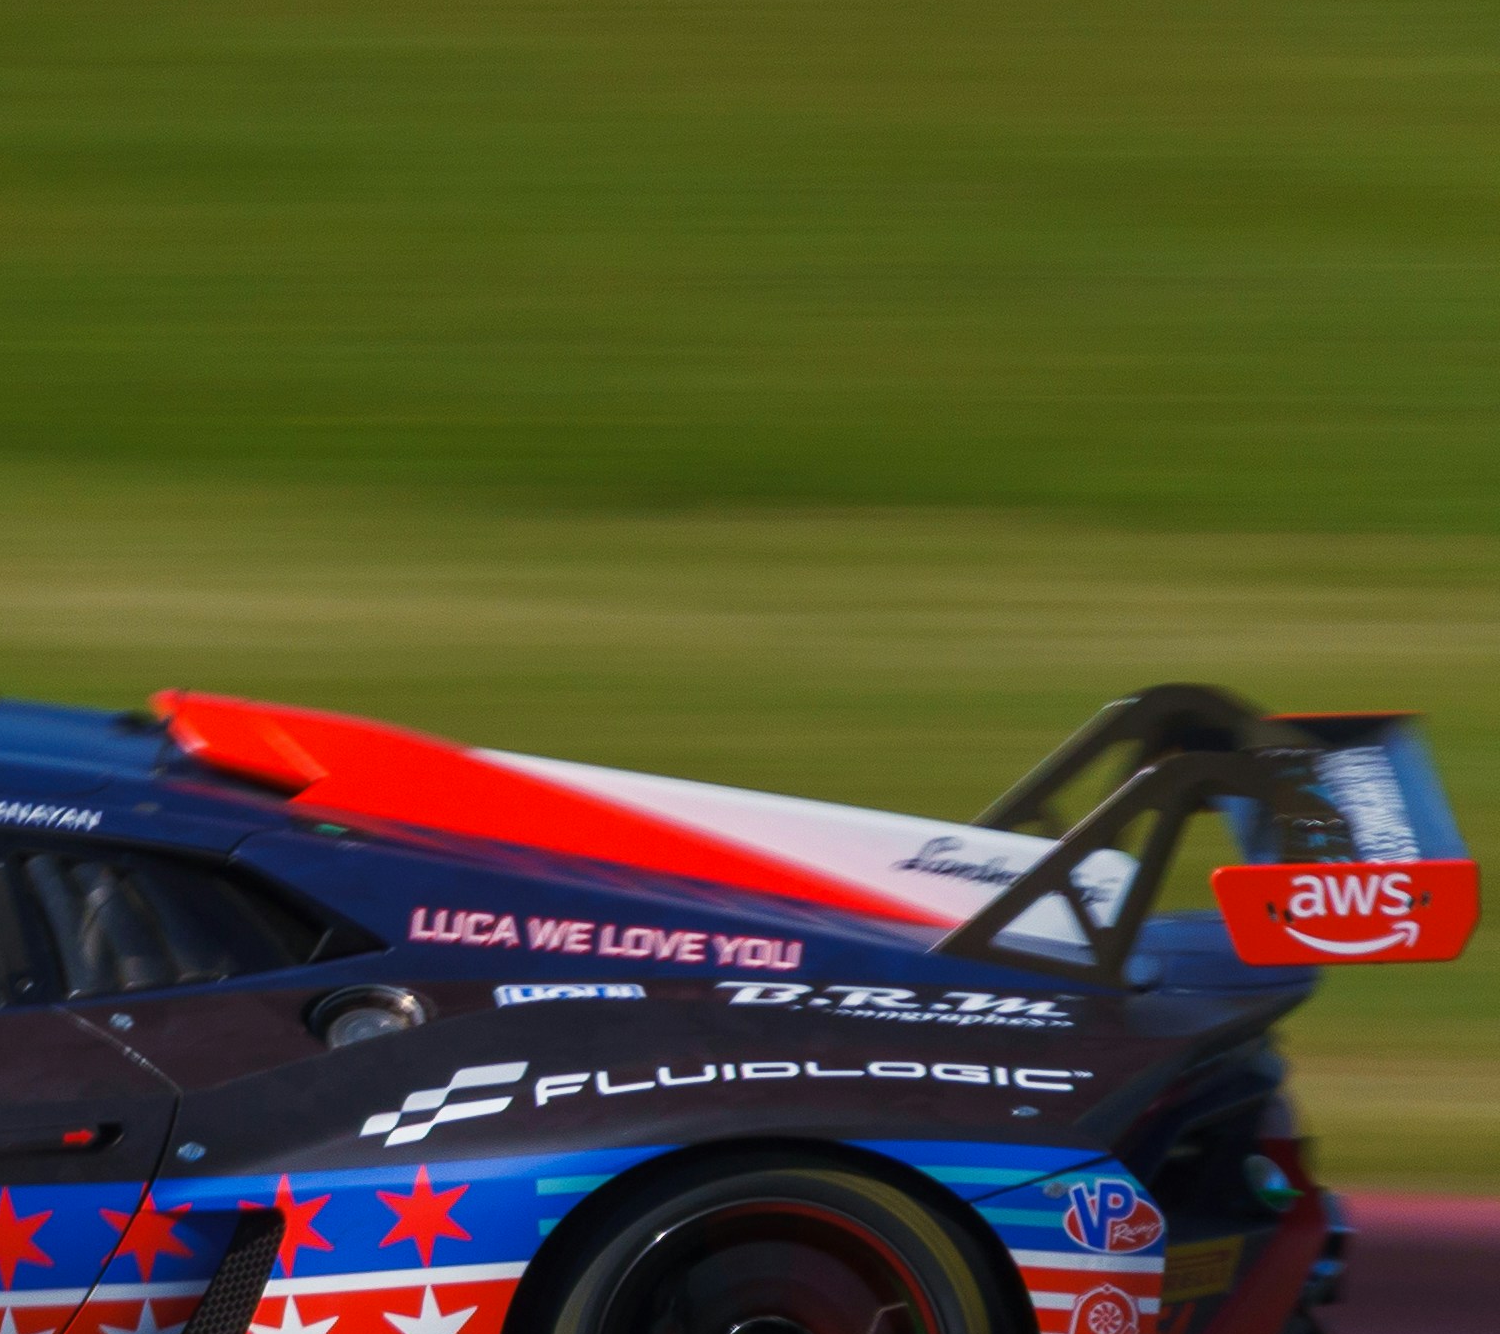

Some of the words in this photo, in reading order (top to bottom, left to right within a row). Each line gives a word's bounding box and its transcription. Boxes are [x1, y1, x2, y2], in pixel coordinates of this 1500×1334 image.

[1289, 873, 1412, 917] aws
[408, 907, 521, 948] LUCA
[526, 917, 595, 954] WE
[596, 924, 707, 962] LOVE
[710, 933, 804, 971] YOU
[534, 1061, 1075, 1107] FLUIDLOGIC
